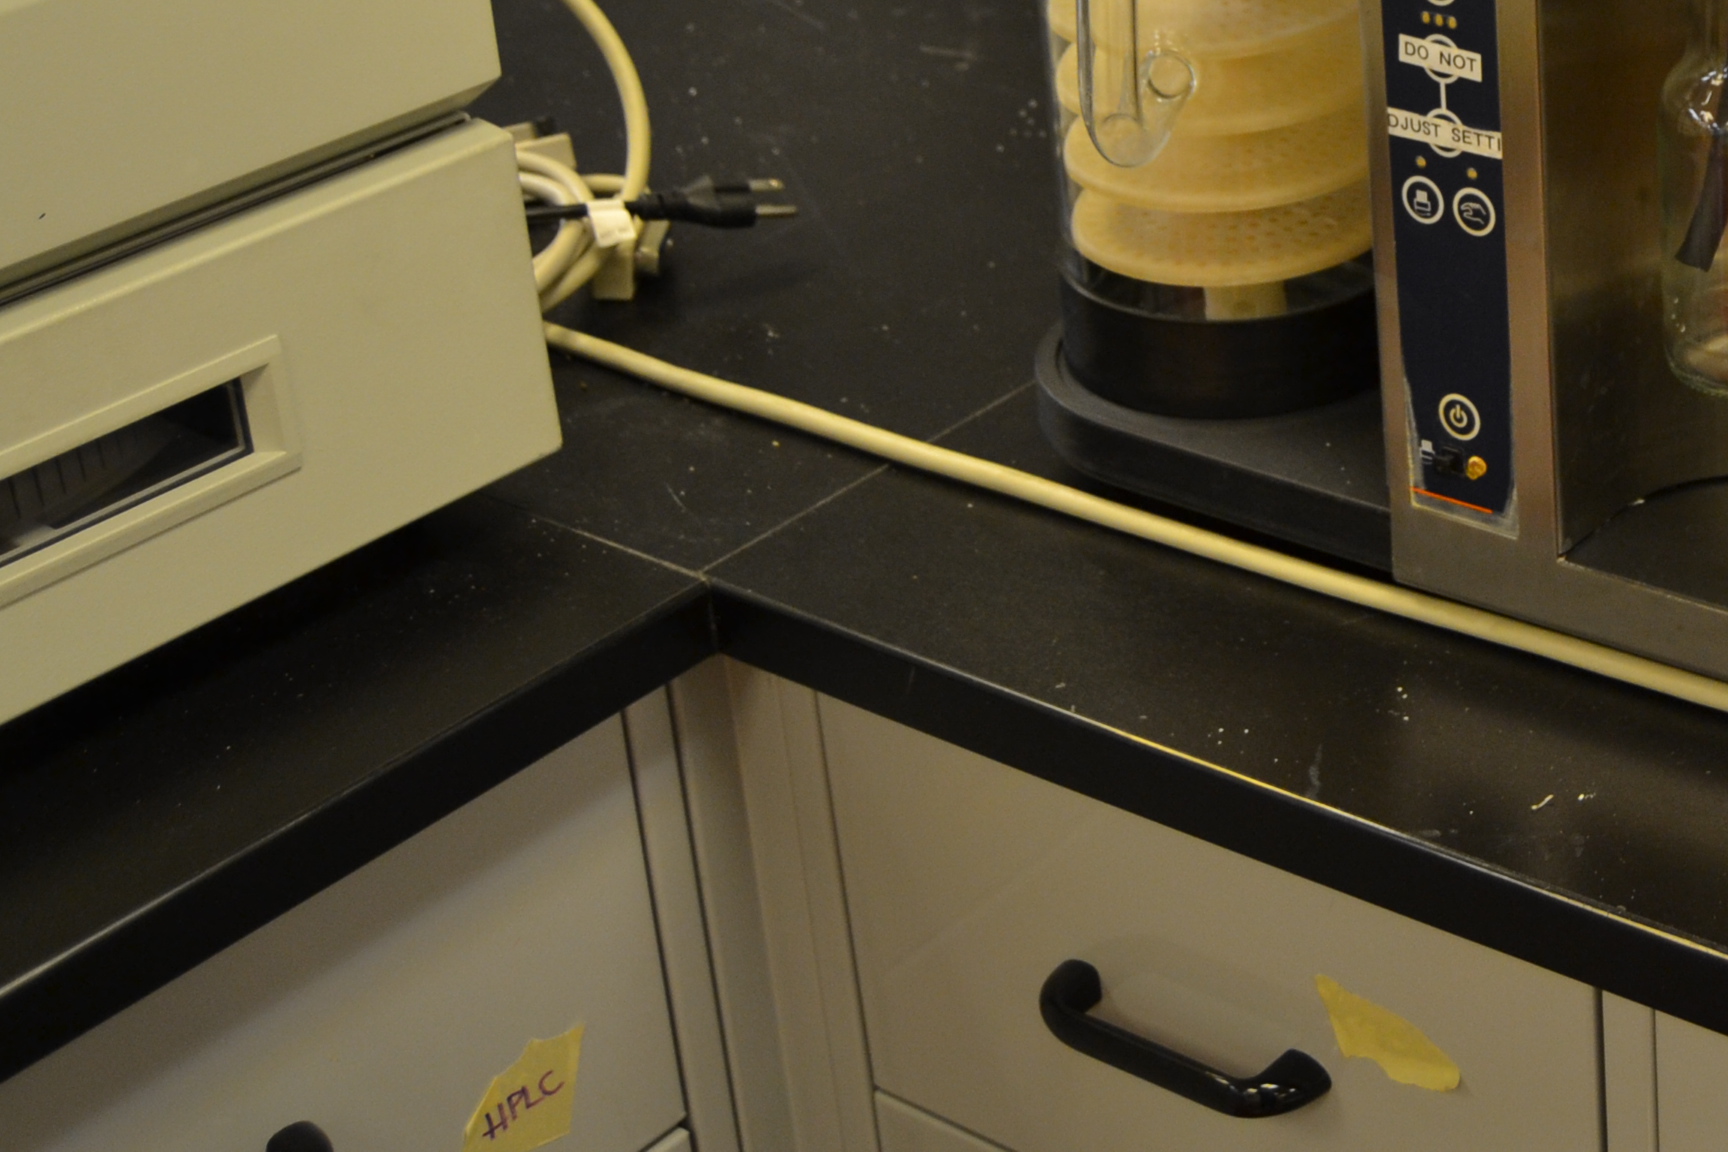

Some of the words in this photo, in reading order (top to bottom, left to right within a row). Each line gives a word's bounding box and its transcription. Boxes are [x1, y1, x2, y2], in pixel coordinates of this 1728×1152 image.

[1404, 41, 1429, 60] DO
[1439, 51, 1477, 72] NOT
[1388, 114, 1440, 138] DJUST
[482, 1070, 565, 1140] HPLC
